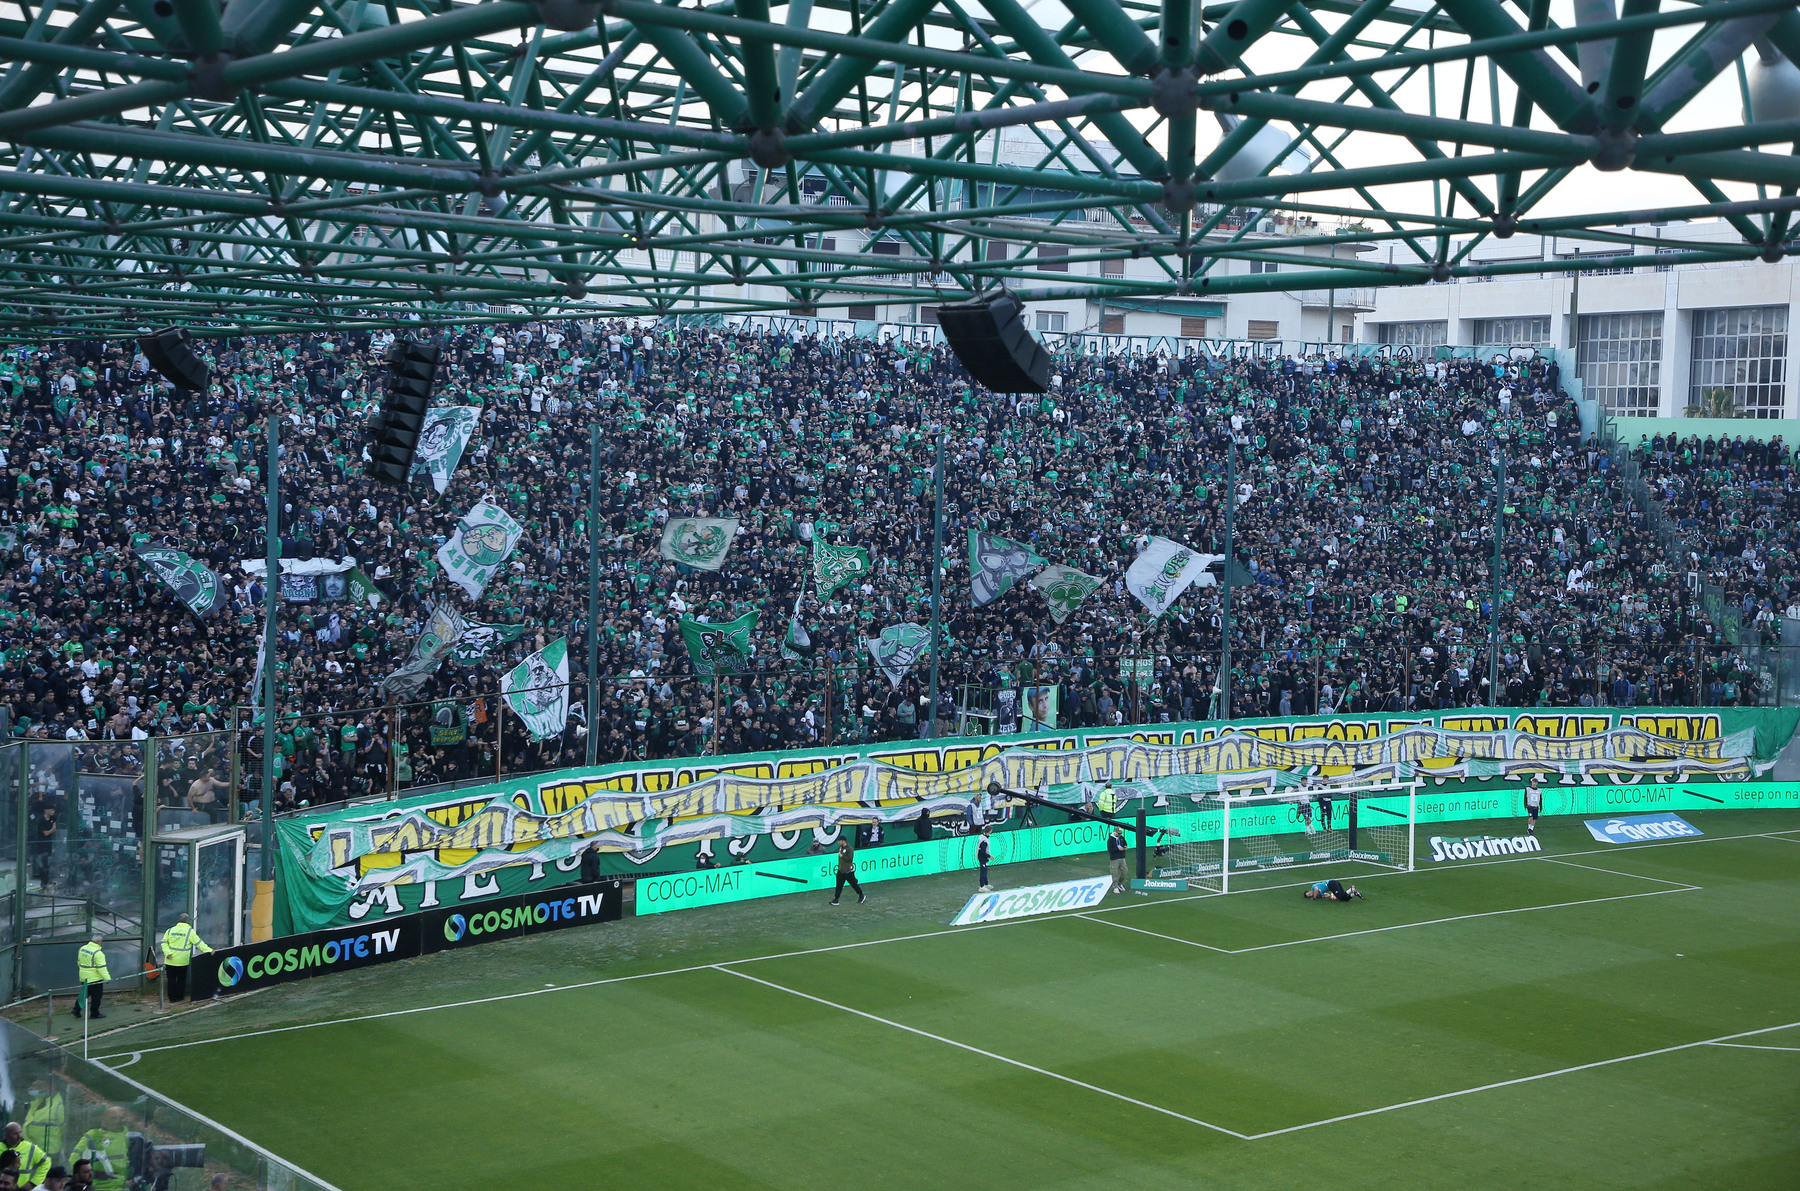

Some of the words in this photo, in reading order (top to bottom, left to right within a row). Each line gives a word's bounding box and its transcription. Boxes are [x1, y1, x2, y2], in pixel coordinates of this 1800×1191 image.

[1606, 787, 1674, 804] COCO-MAT
[1734, 788, 1764, 802] sleep
[1768, 789, 1782, 800] on
[1417, 802, 1446, 815] sleep
[1449, 801, 1461, 812] on
[1463, 799, 1499, 811] nature
[1191, 818, 1220, 833] sleep
[1241, 814, 1277, 827] nature
[1622, 819, 1695, 841] avance
[1309, 851, 1331, 860] Stoiximan
[1349, 850, 1379, 861] Stoiximan
[1430, 835, 1541, 862] Stoiximan
[1199, 863, 1220, 873] Stoiximan
[1236, 858, 1257, 868] Stoiximan
[1273, 855, 1294, 865] Stoiximan
[647, 870, 744, 902] COCO-MAT
[861, 859, 877, 871] on
[881, 850, 924, 870] nature
[1160, 868, 1182, 878] Stoiximan
[1144, 879, 1177, 888] Stoiximan
[994, 882, 1104, 917] COSMOTE
[469, 898, 576, 936] COSMOTE
[577, 893, 604, 917] TV
[247, 935, 370, 979] COSMOTE
[371, 928, 400, 955] TV
